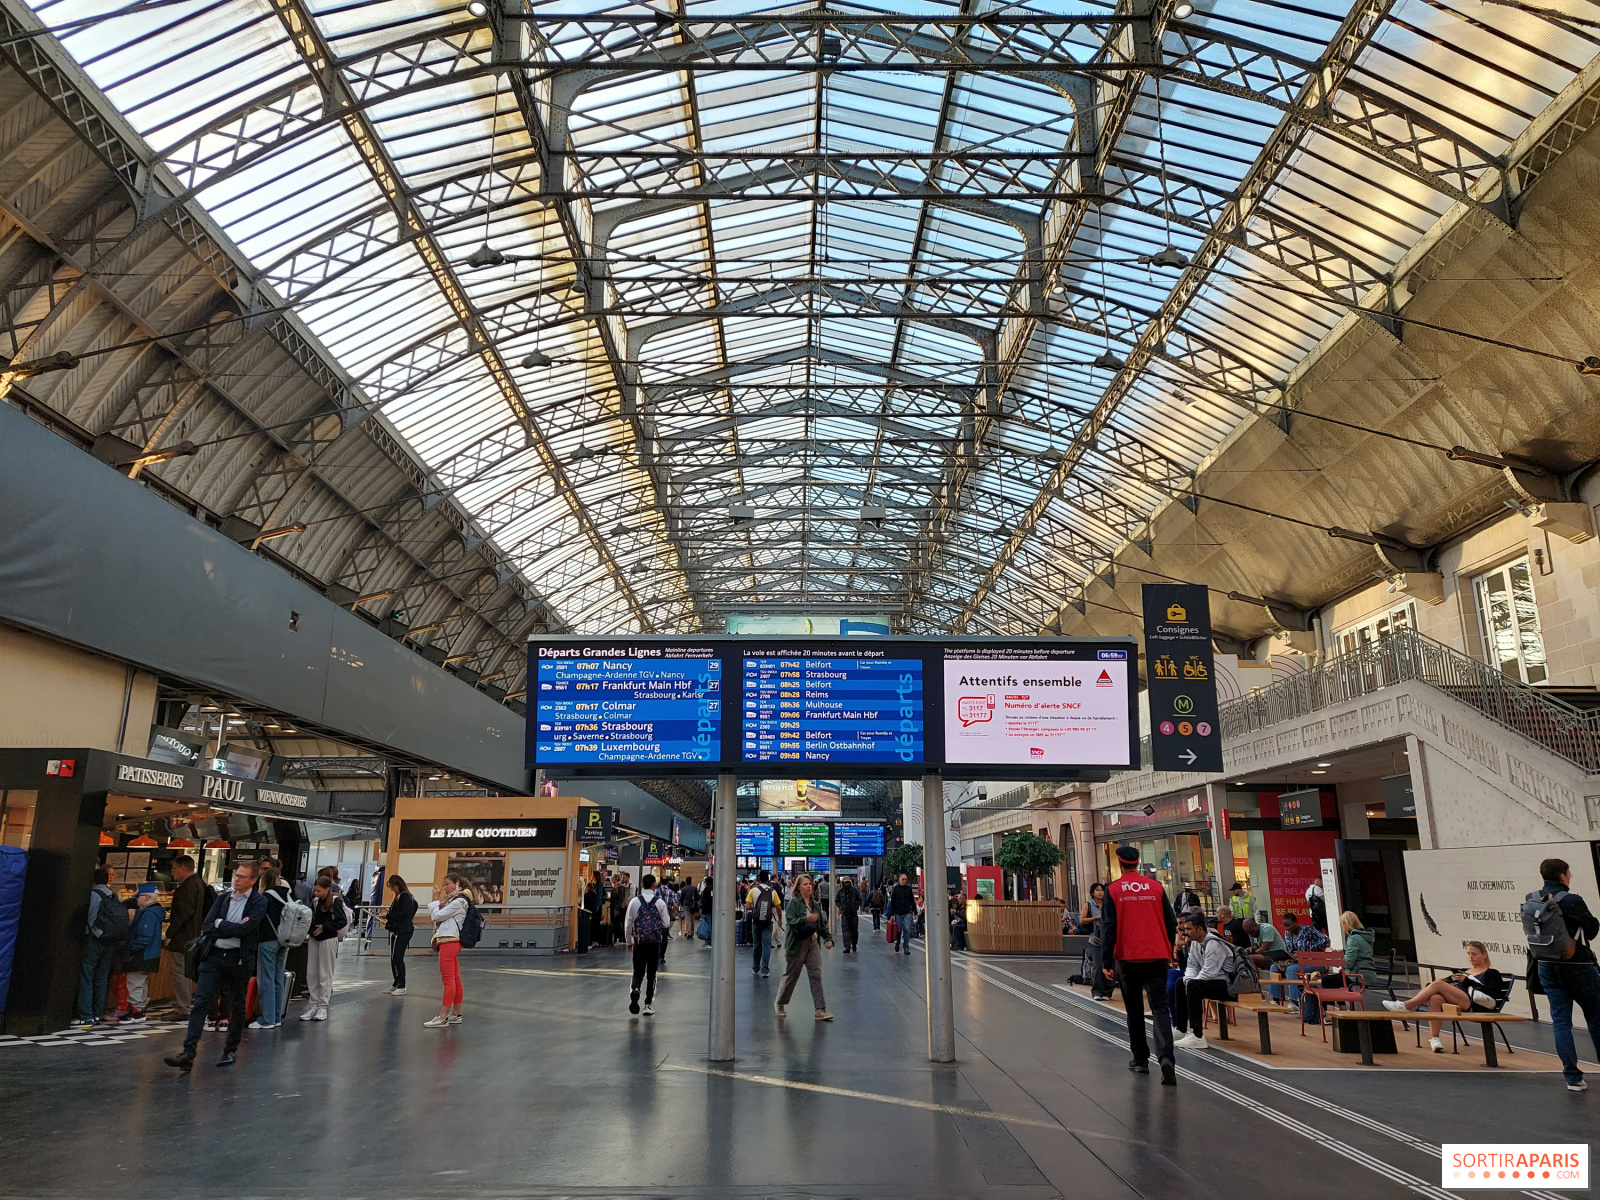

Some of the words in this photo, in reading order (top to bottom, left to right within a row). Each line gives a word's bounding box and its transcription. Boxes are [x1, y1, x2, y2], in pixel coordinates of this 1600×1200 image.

[1156, 626, 1200, 635] Consignes
[538, 648, 580, 659] Départs
[582, 648, 626, 657] Grandes
[628, 648, 661, 658] Lignes
[603, 661, 633, 671] Nancy
[556, 672, 637, 680] Champagne-Ardenne
[661, 671, 685, 679] Nancy
[806, 671, 847, 680] Strasbourg
[603, 681, 646, 690] Frankfurt
[649, 681, 671, 690] Main
[674, 681, 692, 689] Hbf
[959, 676, 1018, 686] Attentifs
[1023, 676, 1082, 687] ensemble
[634, 691, 676, 700] Strasbourg
[602, 701, 636, 710] Colmar
[1178, 699, 1189, 709] M
[555, 712, 597, 721] Strasbourg
[692, 673, 716, 761] départs
[806, 711, 841, 719] Frankfurt
[843, 711, 861, 719] Main
[864, 711, 878, 719] Hbf
[895, 673, 918, 762] départs
[602, 722, 653, 732] Strasbourg
[1164, 724, 1170, 732] 4
[1183, 724, 1188, 732] 5
[1201, 725, 1207, 733] 7
[554, 734, 567, 742] urg
[610, 732, 653, 741] Strasbourg
[806, 731, 832, 739] Belfort
[601, 742, 660, 752] Luxembourg
[599, 752, 680, 762] Champagne-Ardenne
[806, 752, 830, 761] Nancy
[118, 765, 184, 789] PATISSERIES
[201, 775, 246, 802] PAUL
[256, 789, 307, 808] VIENNOISERIES
[430, 829, 445, 838] LE
[446, 828, 474, 838] PAIN
[475, 828, 537, 838] QUOTIDIEN
[511, 868, 532, 876] because
[511, 878, 527, 886] tastes
[540, 878, 556, 886] better
[1467, 881, 1478, 890] AUX
[1480, 881, 1515, 890] CHEMINOTS
[1463, 910, 1470, 919] DU
[1472, 911, 1495, 921] RESEAU
[1498, 912, 1506, 922] DE
[1483, 942, 1500, 953] POUR
[1502, 944, 1511, 954] LA
